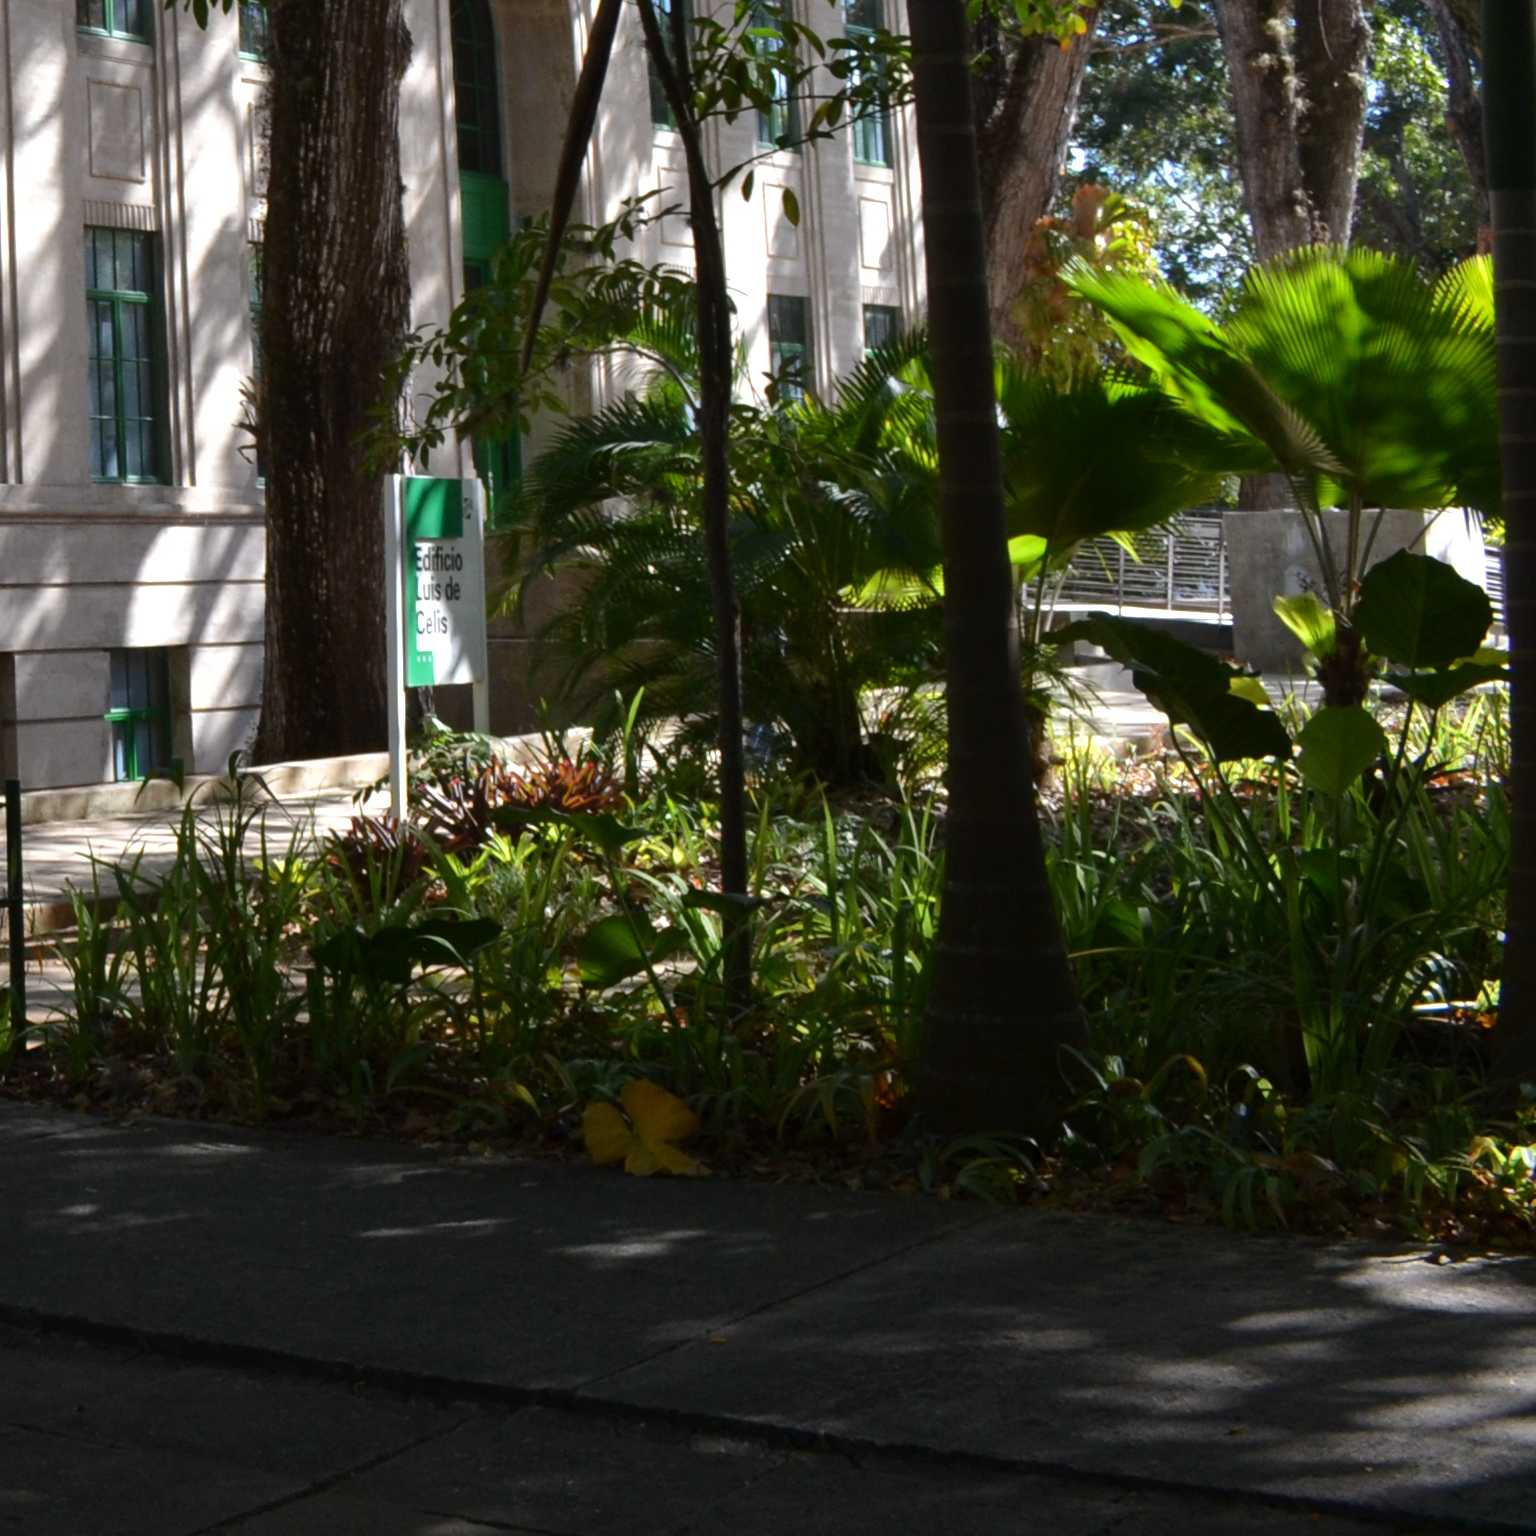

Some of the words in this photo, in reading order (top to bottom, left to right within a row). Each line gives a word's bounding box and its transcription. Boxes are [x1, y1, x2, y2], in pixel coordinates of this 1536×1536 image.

[416, 546, 463, 572] Edificio
[416, 576, 442, 601] Luis
[445, 576, 461, 601] de
[416, 609, 448, 635] Celis
